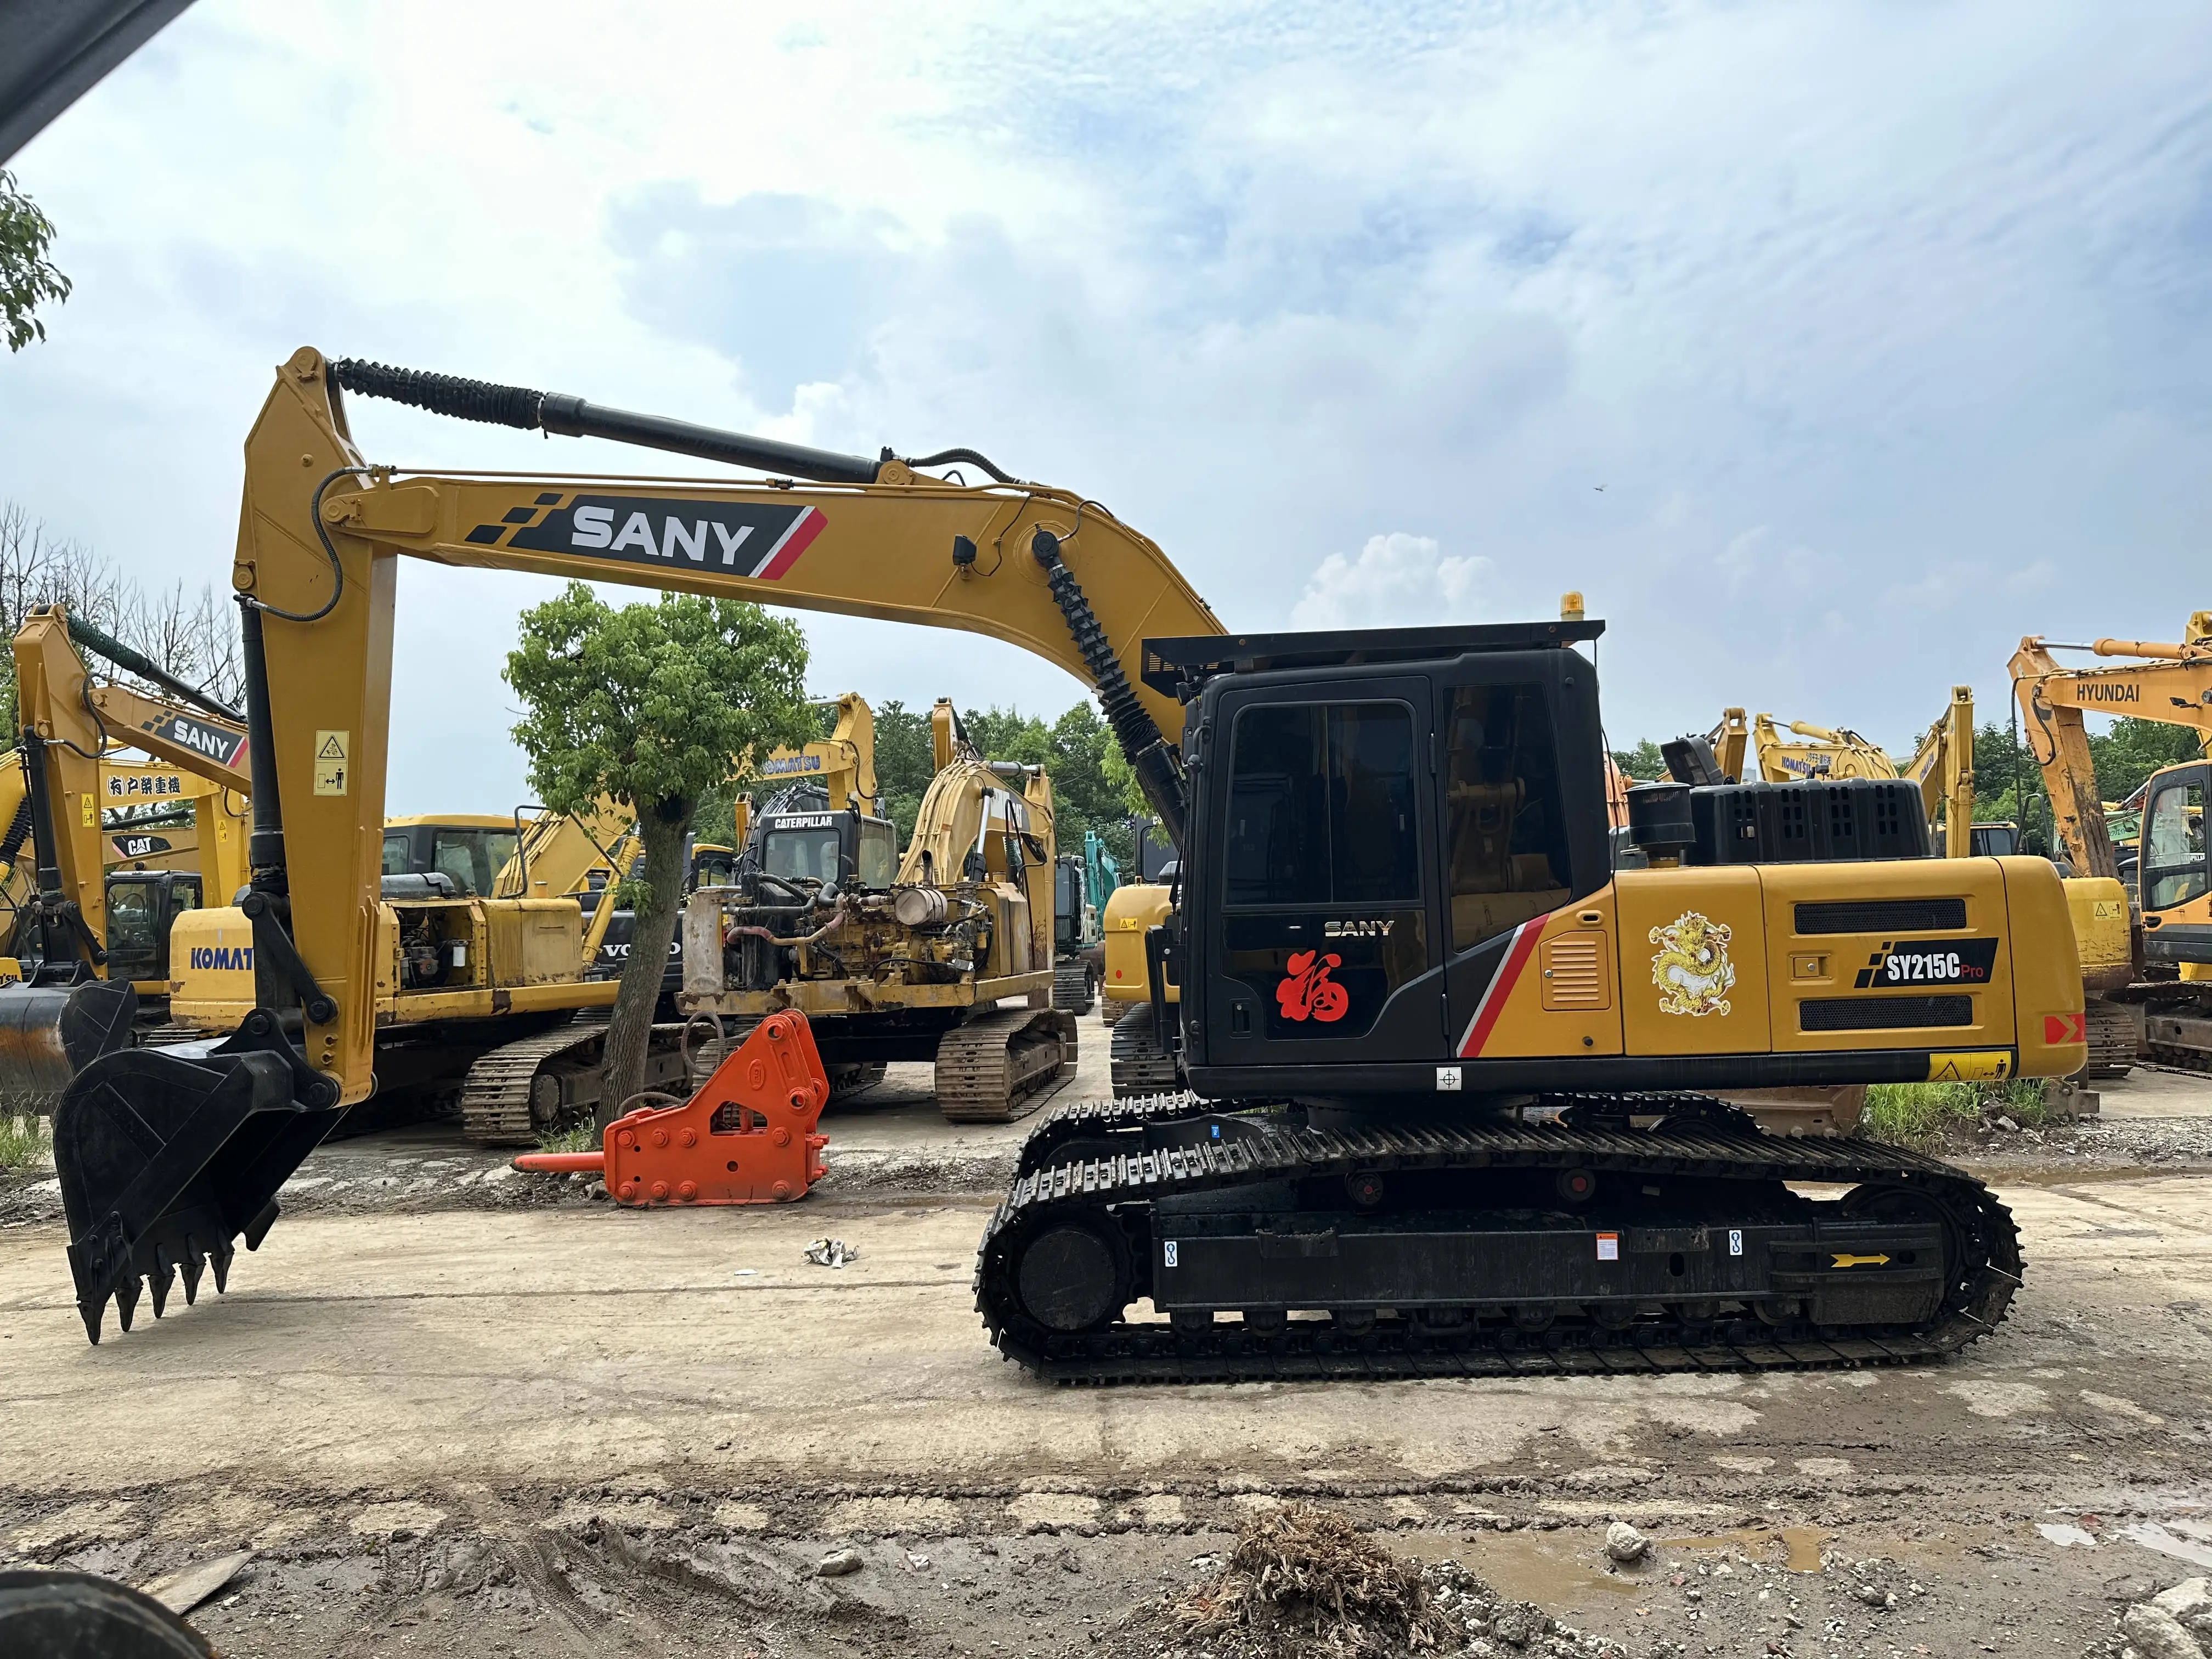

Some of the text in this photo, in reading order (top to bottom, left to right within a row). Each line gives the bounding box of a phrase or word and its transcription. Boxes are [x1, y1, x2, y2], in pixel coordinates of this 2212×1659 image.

[571, 506, 755, 565] SANY
[2077, 684, 2140, 702] HYUNDAI
[174, 720, 229, 759] SANY
[761, 752, 821, 775] OMATSU
[1782, 755, 1811, 775] KOMATSU
[775, 816, 833, 828] CATERPILLAR
[128, 837, 151, 855] CAT
[1324, 921, 1395, 936] SANY
[191, 947, 253, 970] KOMAT
[603, 942, 681, 957] VOO
[1887, 952, 1984, 980] SY215C Pro
